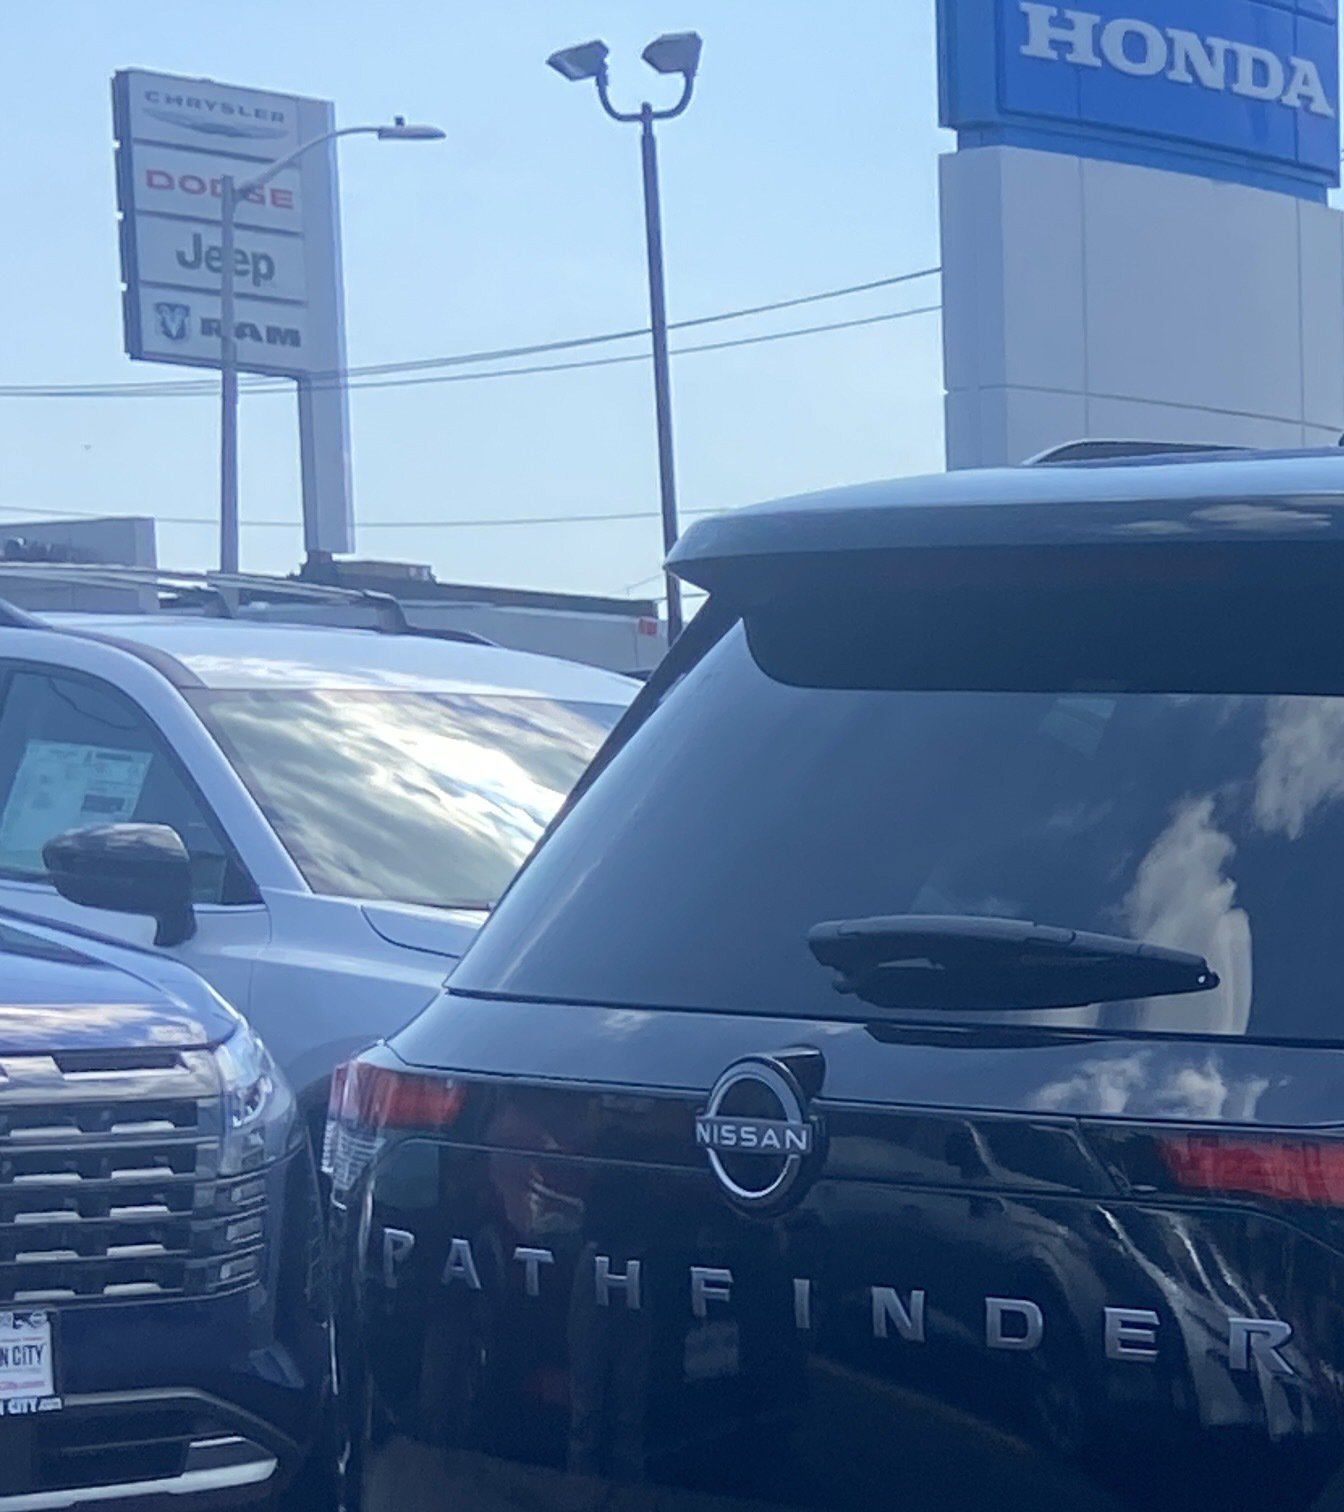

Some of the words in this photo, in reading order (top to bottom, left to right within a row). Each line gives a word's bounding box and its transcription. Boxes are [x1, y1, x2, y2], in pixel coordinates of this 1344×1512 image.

[1019, 1, 1335, 119] HONDA
[144, 90, 286, 124] CHRYSLER
[175, 233, 276, 287] Jeep
[200, 316, 302, 349] RAM
[696, 1122, 807, 1150] NISSAN
[381, 1227, 1297, 1375] PATHFINDER
